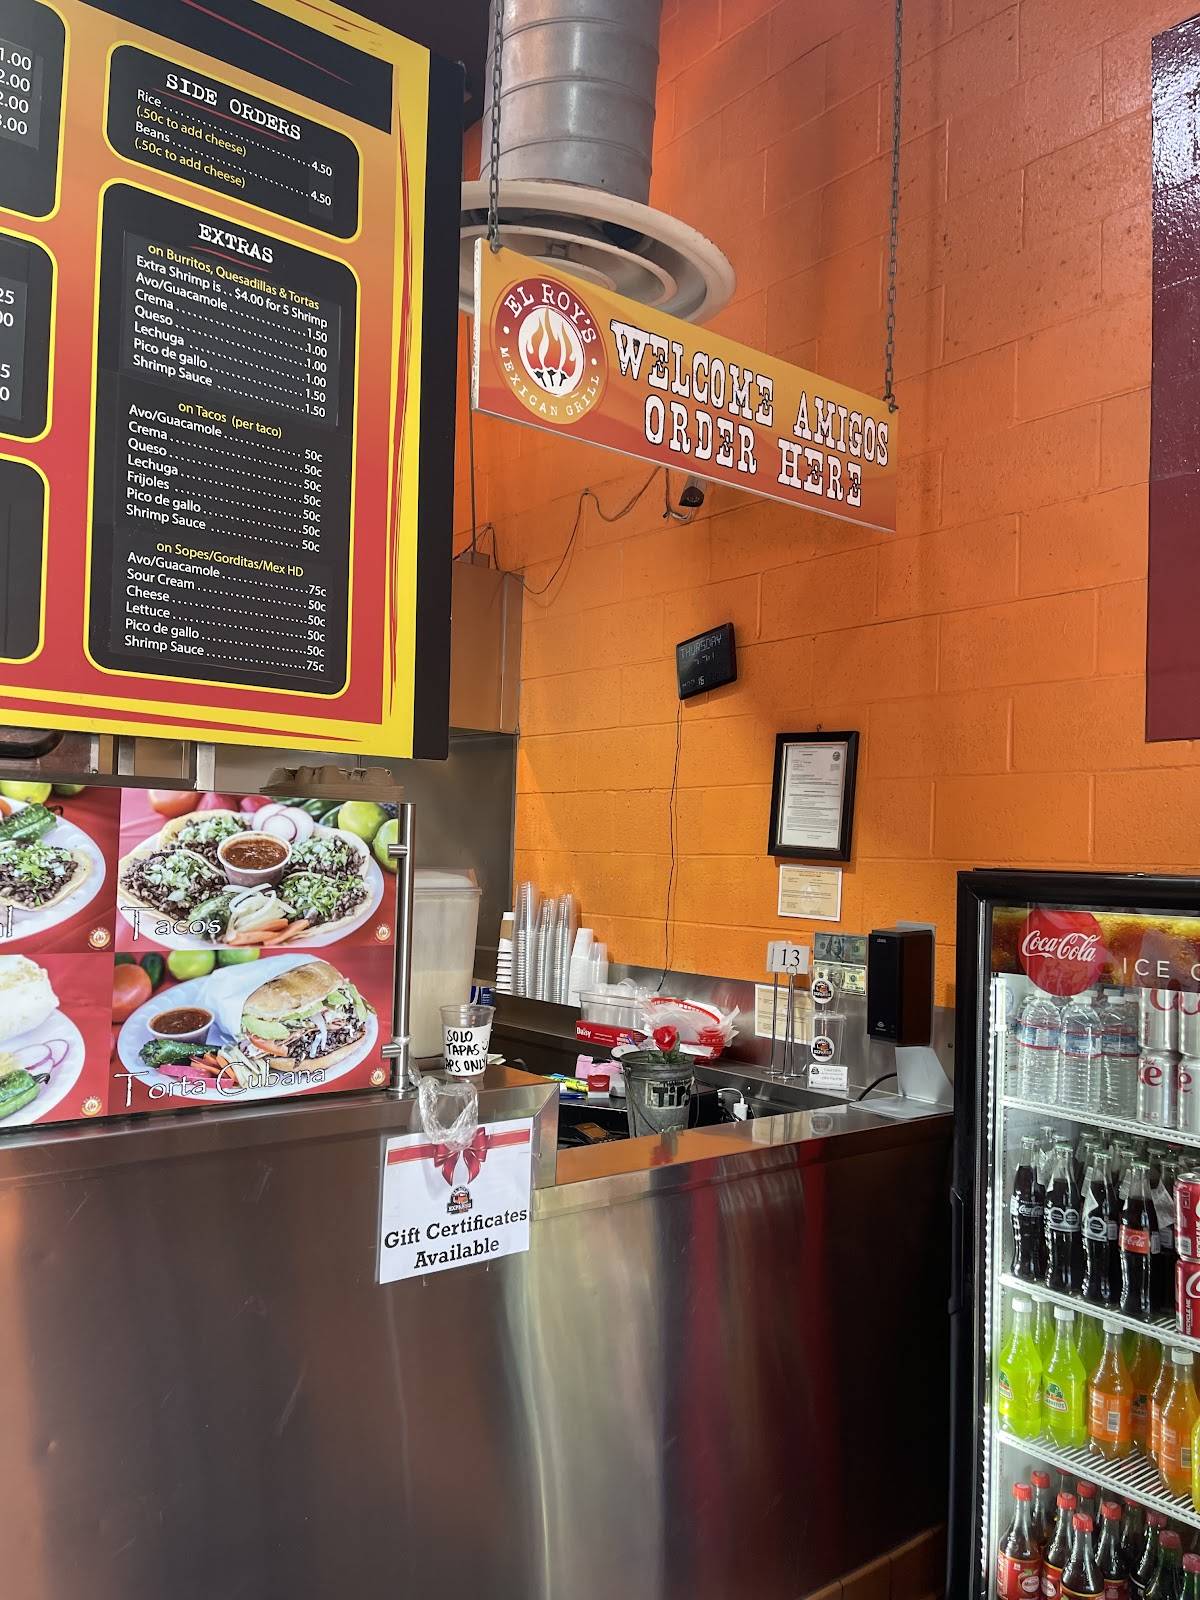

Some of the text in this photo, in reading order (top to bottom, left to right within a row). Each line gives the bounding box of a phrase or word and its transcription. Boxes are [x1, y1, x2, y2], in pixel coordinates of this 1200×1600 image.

[136, 105, 247, 158] (.50c to add cheese)
[137, 88, 333, 177] Rice 4.50
[166, 73, 301, 140] SIDE ORDERS
[134, 137, 246, 189] (.50c to add cheese)
[135, 121, 331, 206] Beans 4.50
[198, 223, 274, 264] EXTRAS
[136, 255, 328, 330] Extra Shrimp is $4.00 for 5 Shrimp
[148, 245, 320, 311] on Burritos, Quesadillas & Tortas
[135, 288, 327, 358] Crema 1.00
[136, 272, 328, 343] Avo/Guacamole 1.50
[504, 283, 597, 344] EL ROY'S
[134, 305, 327, 373] Queso 1.00
[134, 321, 327, 388] Lechuga 1.00
[133, 337, 326, 403] Pico de gallo 1.50
[133, 354, 326, 418] Shrimp Sauce 1.50
[500, 346, 600, 416] MEXICAN GRILL
[610, 319, 889, 466] WELCOME AMIGOS
[129, 404, 323, 463] Avo/Guacamole 50c
[178, 402, 282, 439] on Tacos (per taco)
[128, 421, 322, 478] Crema 50c
[128, 437, 322, 493] Queso 50c
[644, 394, 862, 507] ORDER HERE
[127, 453, 321, 508] Lechuga 50c
[127, 470, 321, 523] Frijoles 50c
[126, 487, 321, 538] Pico de gallo 50c
[126, 504, 320, 553] Shrimp Sauce 50c
[127, 551, 327, 597] Avo/Guacamole 75c
[157, 543, 304, 578] on Sopes/Gorditas/Mex HD
[126, 584, 326, 627] Cheese 50c
[127, 568, 326, 612] Sour Cream 50c
[125, 618, 325, 658] Pico de gallo 50c
[126, 601, 325, 643] Lettuce 50c
[125, 634, 325, 672] Shrimp Sauce 75c
[121, 906, 221, 941] Tacos
[782, 948, 800, 967] 13
[1123, 957, 1170, 979] ICE
[446, 1042, 480, 1056] TAPAS
[447, 1029, 473, 1043] SOLO
[576, 1026, 591, 1039] Daisy
[114, 1071, 207, 1107] Torta
[216, 1059, 326, 1097] Cubana
[384, 1208, 528, 1249] Gift Certificates
[414, 1237, 500, 1269] Available
